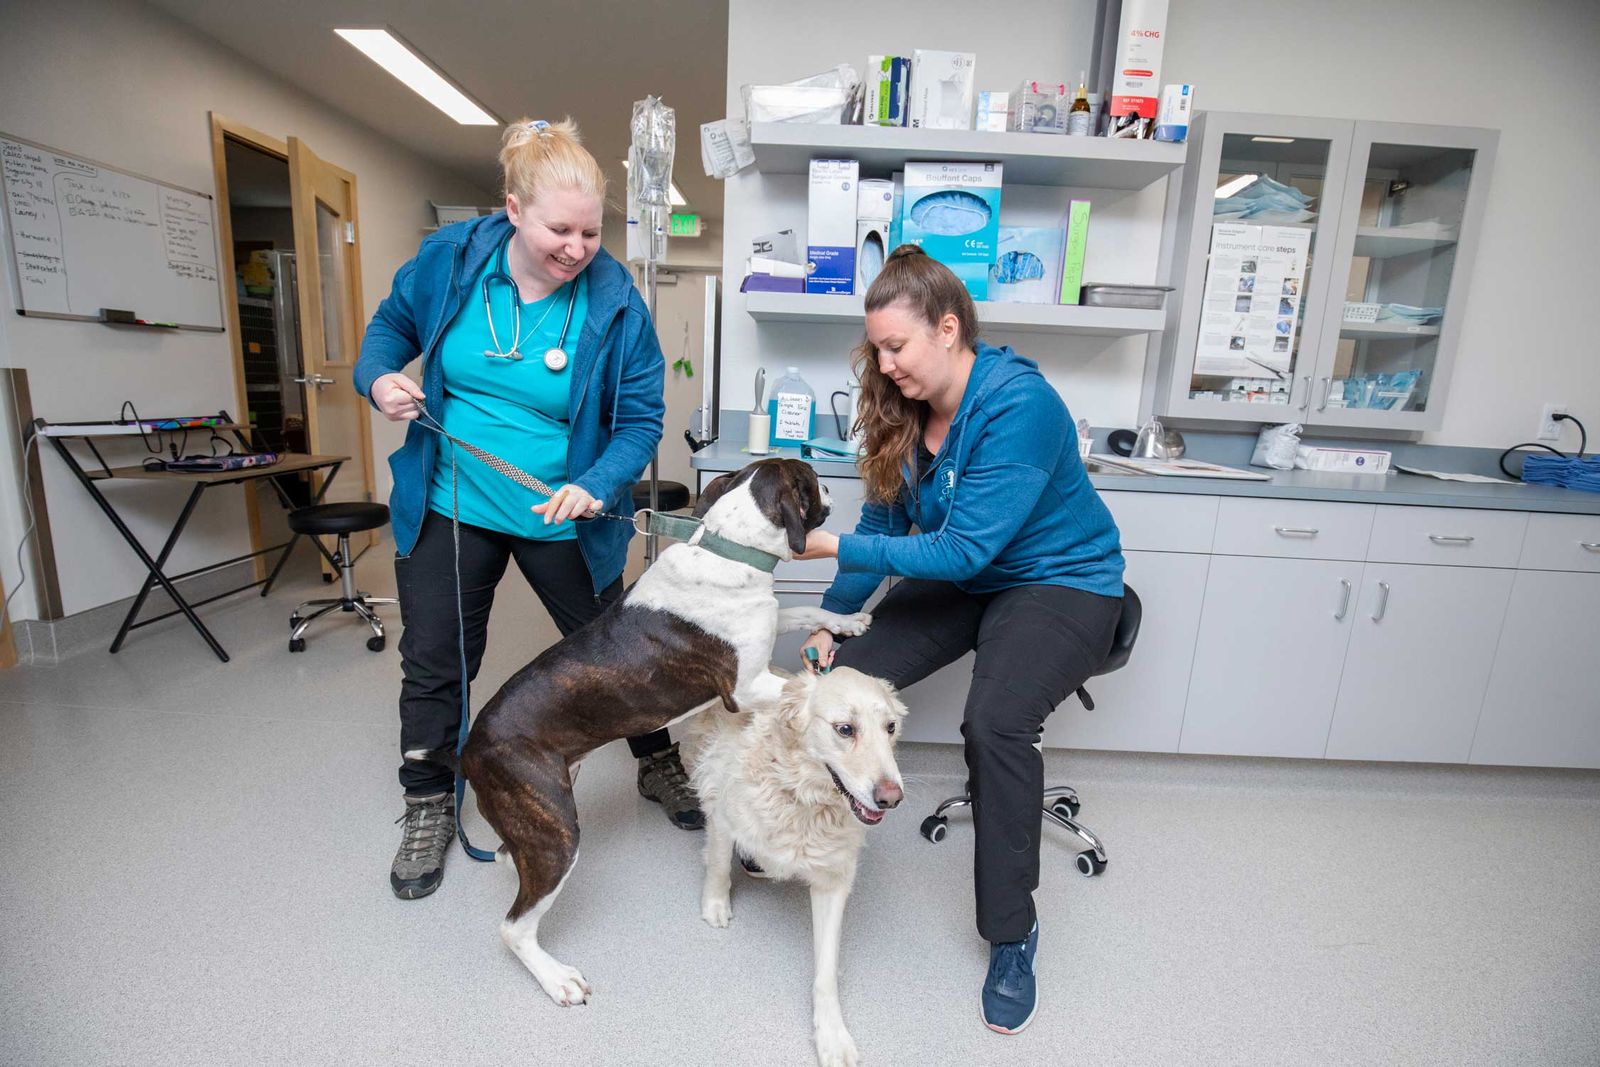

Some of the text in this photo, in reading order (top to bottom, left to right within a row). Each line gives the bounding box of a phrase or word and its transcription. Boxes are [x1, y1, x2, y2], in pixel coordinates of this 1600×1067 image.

[1144, 30, 1160, 38] CHG
[926, 174, 982, 183] Bouffant Caps
[672, 215, 697, 234] EXIT
[1257, 244, 1275, 252] care
[1276, 246, 1296, 254] steps
